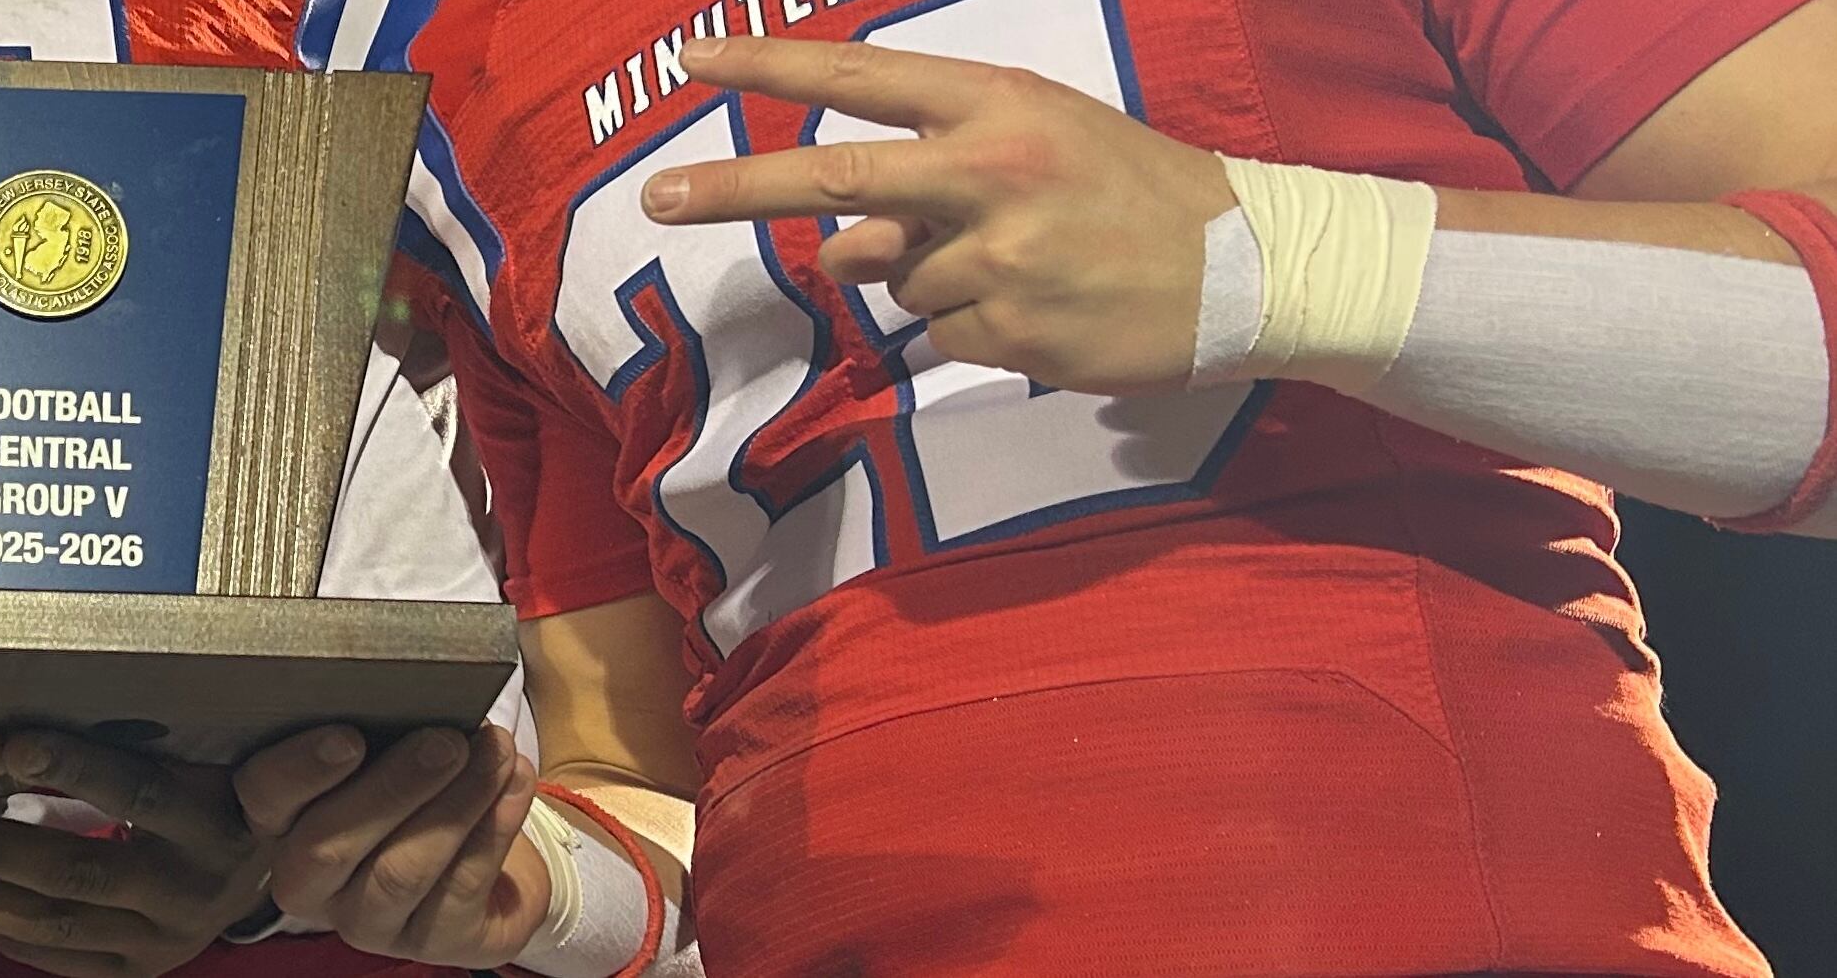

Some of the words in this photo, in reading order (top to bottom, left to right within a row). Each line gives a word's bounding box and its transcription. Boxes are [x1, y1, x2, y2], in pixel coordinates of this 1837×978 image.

[19, 179, 73, 194] JERSEY
[75, 186, 110, 220] STATE
[76, 229, 92, 263] 1918
[52, 271, 109, 309] ATHLETIC
[104, 486, 129, 518] V
